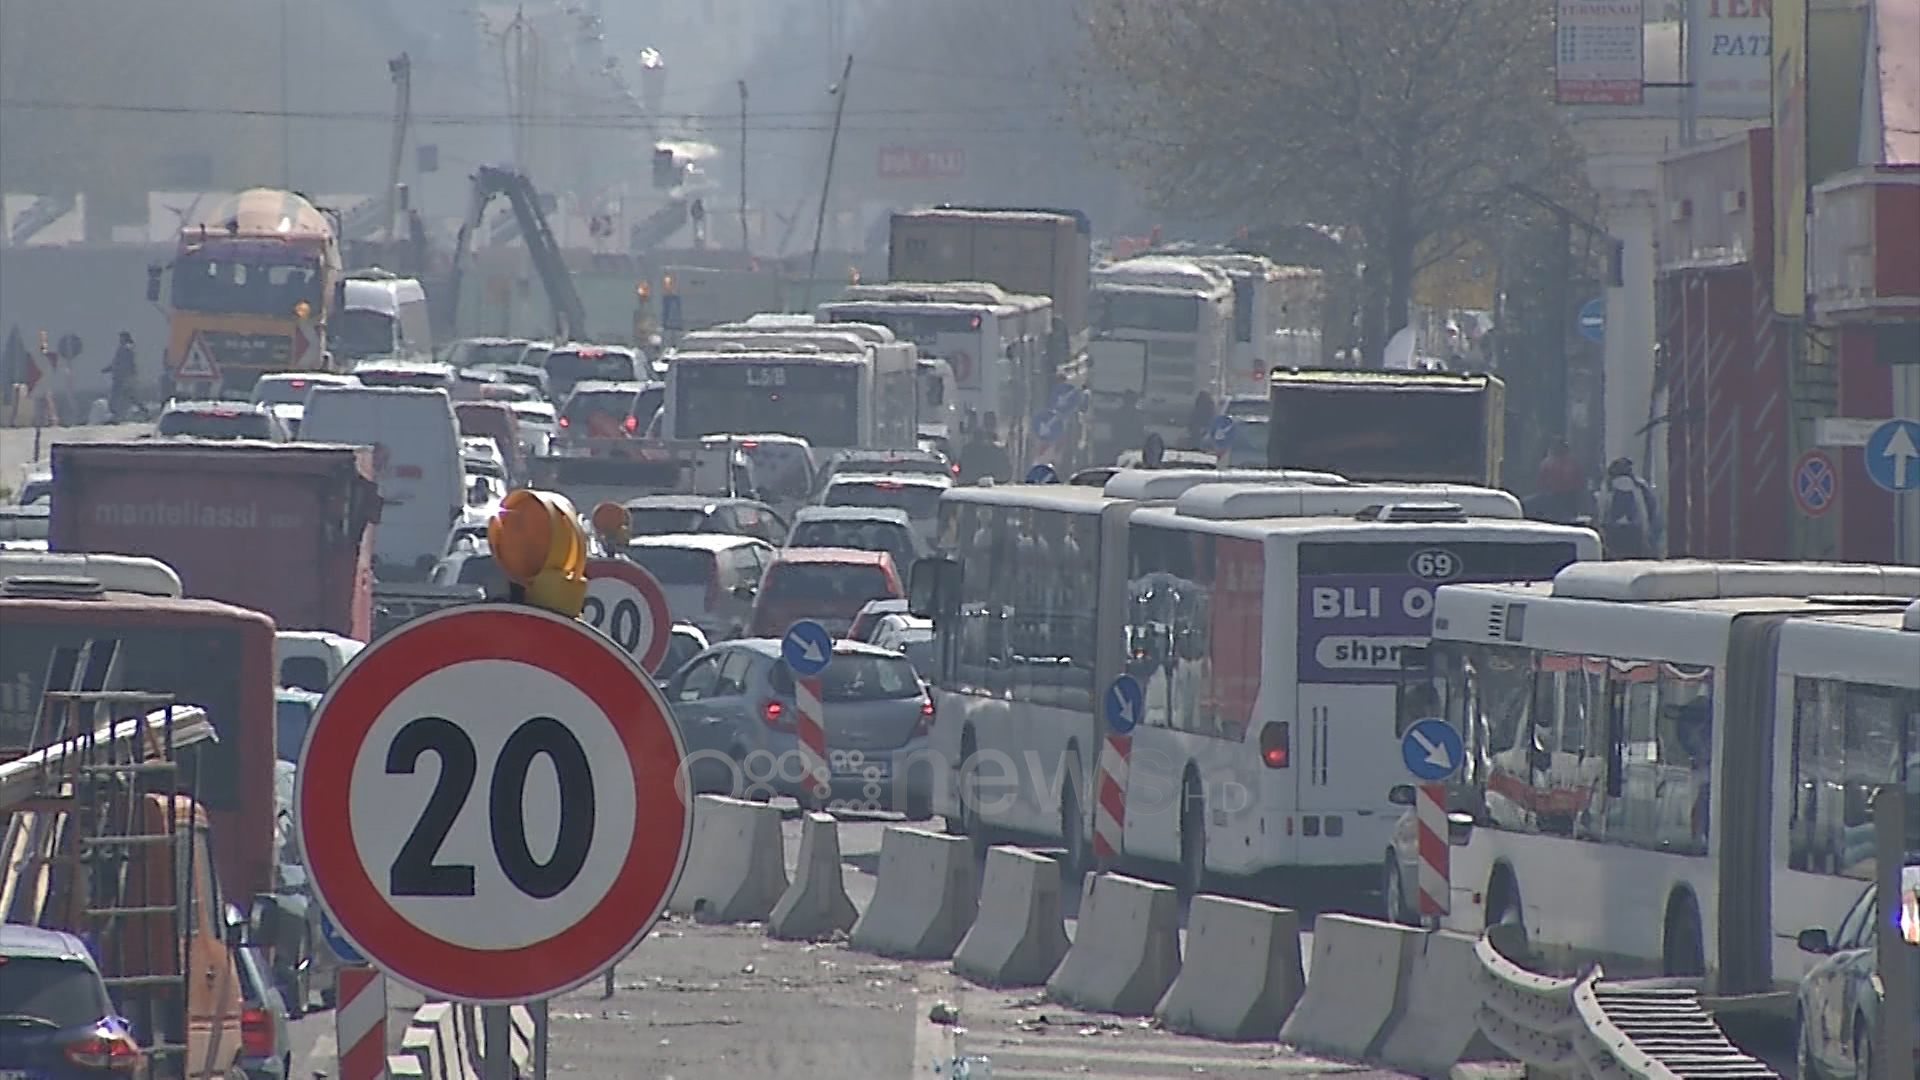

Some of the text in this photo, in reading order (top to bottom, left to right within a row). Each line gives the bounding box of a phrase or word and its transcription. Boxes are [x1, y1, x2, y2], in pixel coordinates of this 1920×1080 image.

[1417, 554, 1452, 577] 69
[1313, 587, 1381, 619] BLI
[385, 716, 596, 900] 20
